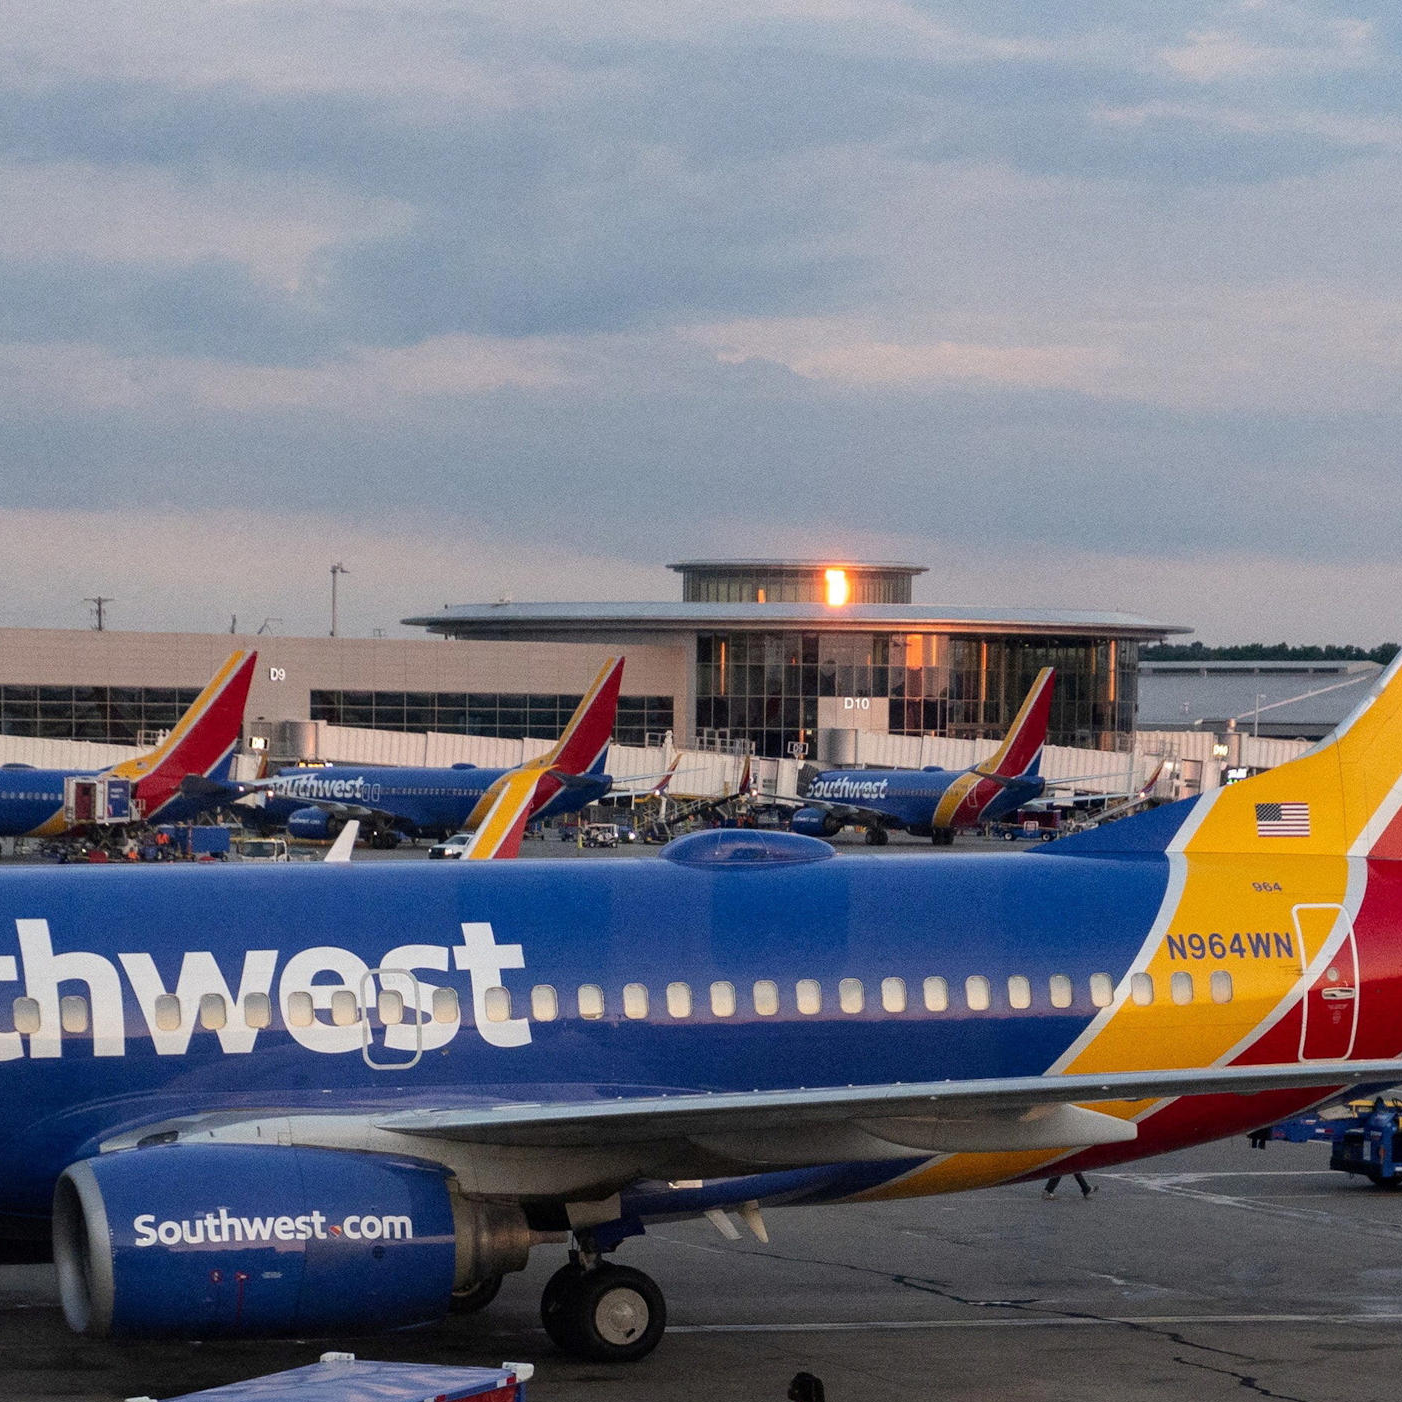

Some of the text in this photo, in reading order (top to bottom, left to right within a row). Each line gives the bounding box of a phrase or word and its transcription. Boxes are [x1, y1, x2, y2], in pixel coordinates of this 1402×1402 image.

[270, 667, 286, 681] D9
[844, 697, 869, 710] D10
[1251, 881, 1283, 893] 964
[1166, 932, 1294, 961] N964WN
